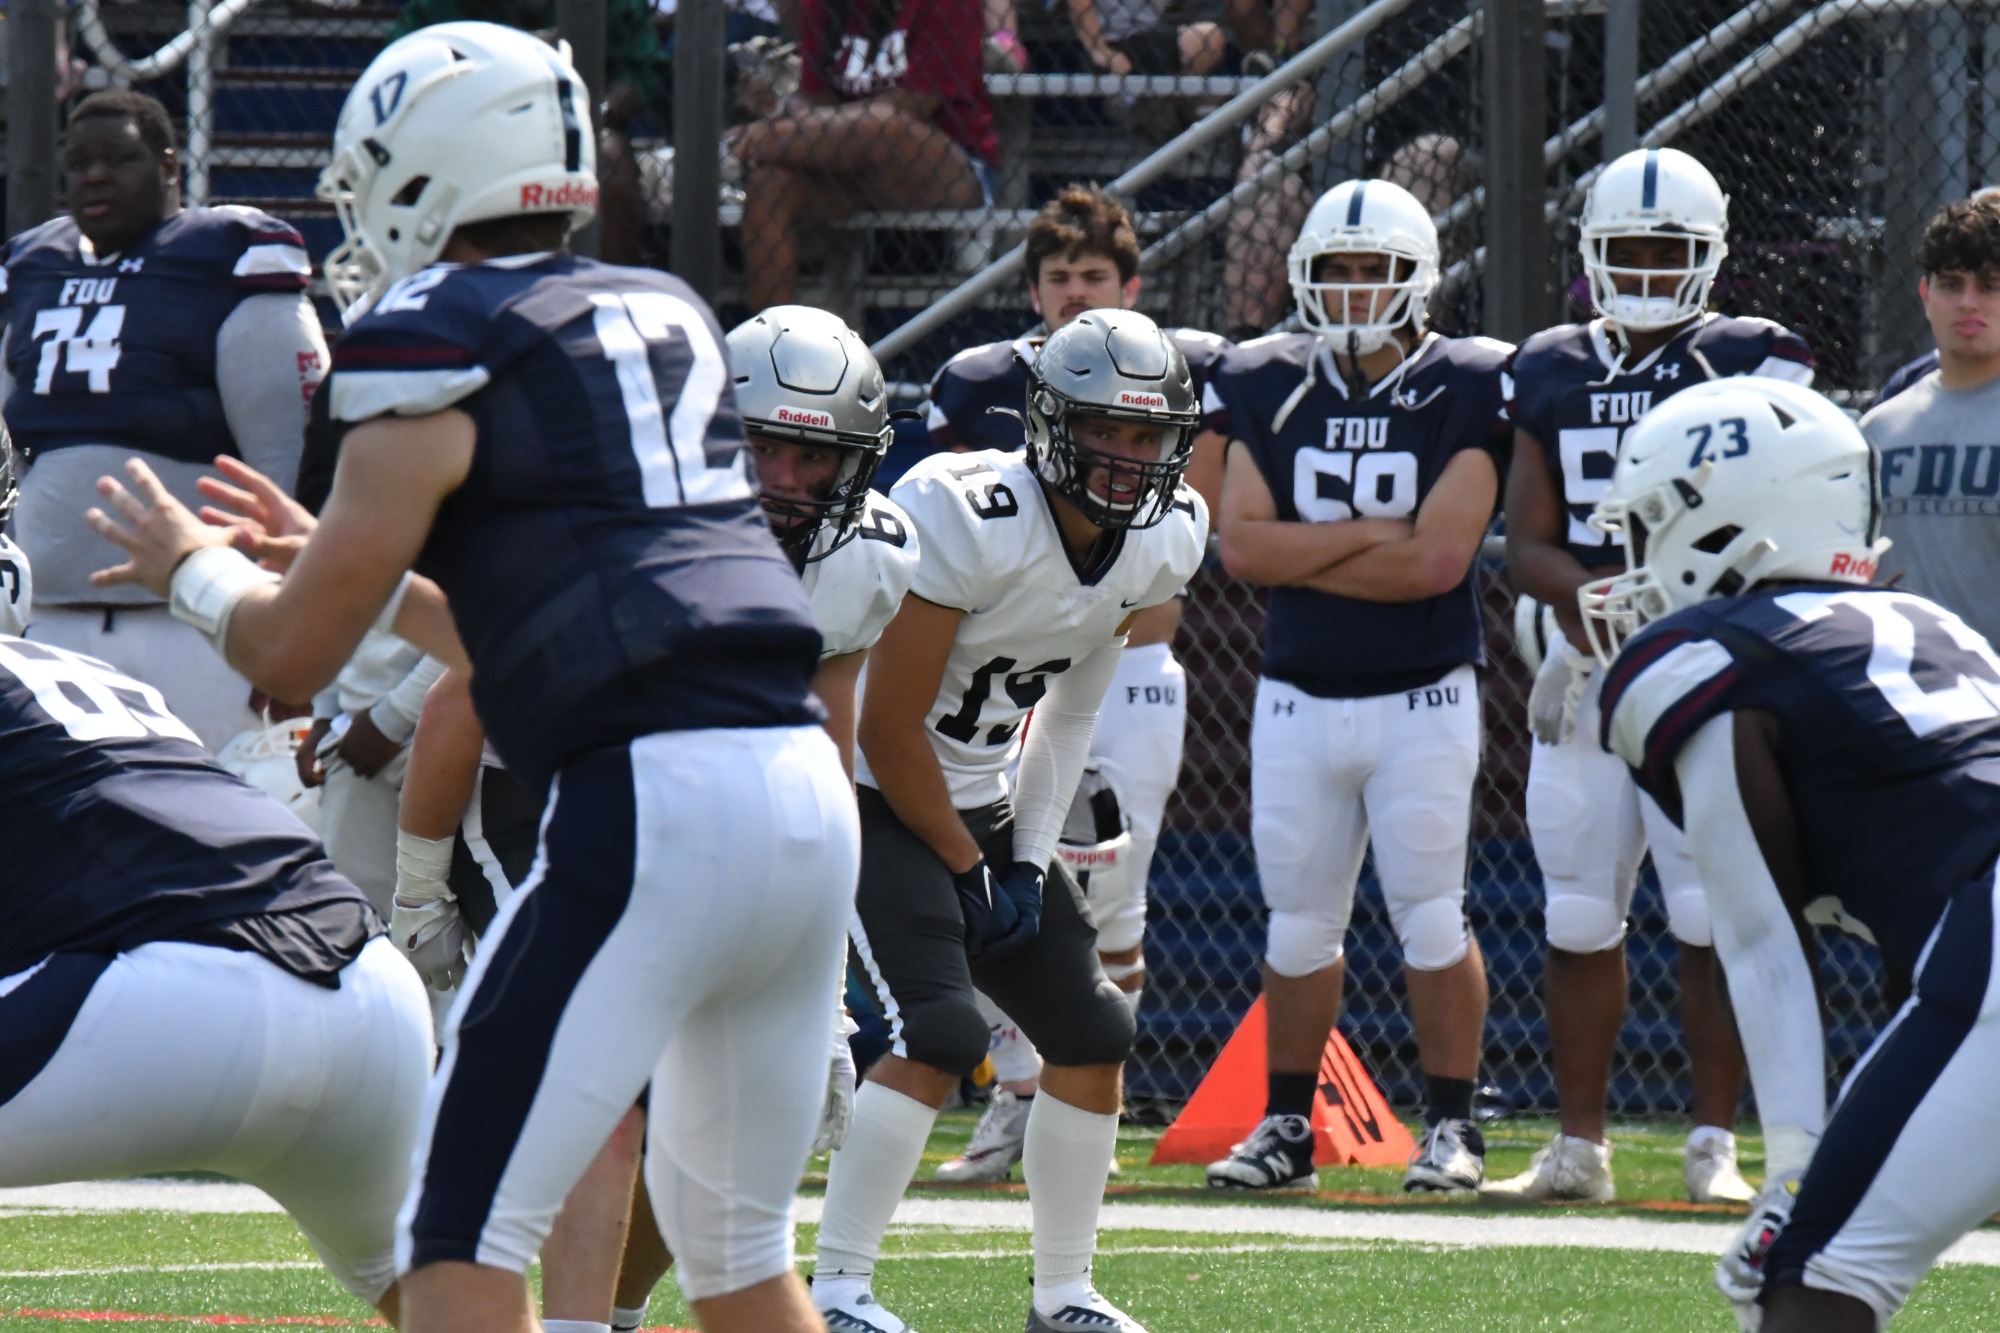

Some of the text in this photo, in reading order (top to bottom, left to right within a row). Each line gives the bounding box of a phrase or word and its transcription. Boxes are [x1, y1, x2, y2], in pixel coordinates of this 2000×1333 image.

[58, 277, 119, 306] FDU
[31, 304, 127, 395] 74
[586, 292, 754, 508] 12
[1121, 394, 1164, 407] Riddell
[1589, 391, 1653, 423] FDU
[778, 409, 829, 427] Riddell
[1326, 416, 1391, 449] FDU
[1686, 416, 1750, 468] 23
[1880, 444, 2000, 497] FDU
[944, 463, 1019, 520] 19
[1126, 686, 1177, 706] FDU
[1407, 686, 1460, 710] FDU
